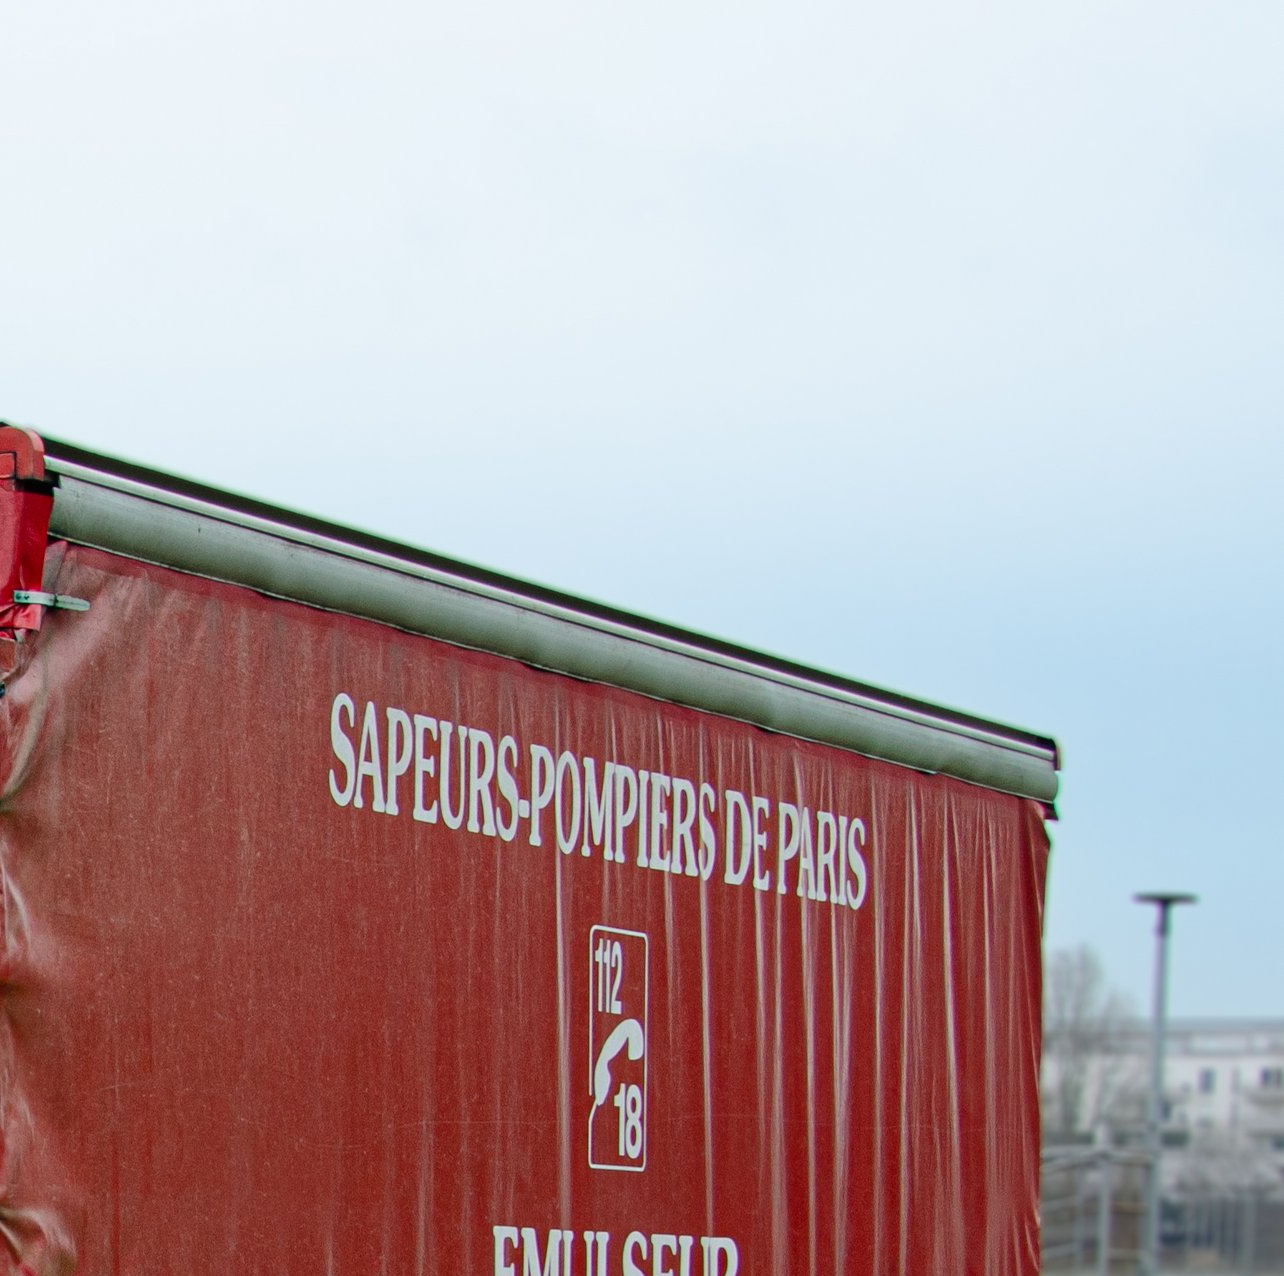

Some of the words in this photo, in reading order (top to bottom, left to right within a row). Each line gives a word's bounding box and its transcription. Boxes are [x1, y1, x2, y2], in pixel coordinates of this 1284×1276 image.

[328, 692, 716, 881] SAPEURS-POMPIERS
[724, 788, 770, 892] DE
[777, 801, 868, 910] PARIS
[593, 938, 623, 1015] 112
[613, 1082, 642, 1159] 18
